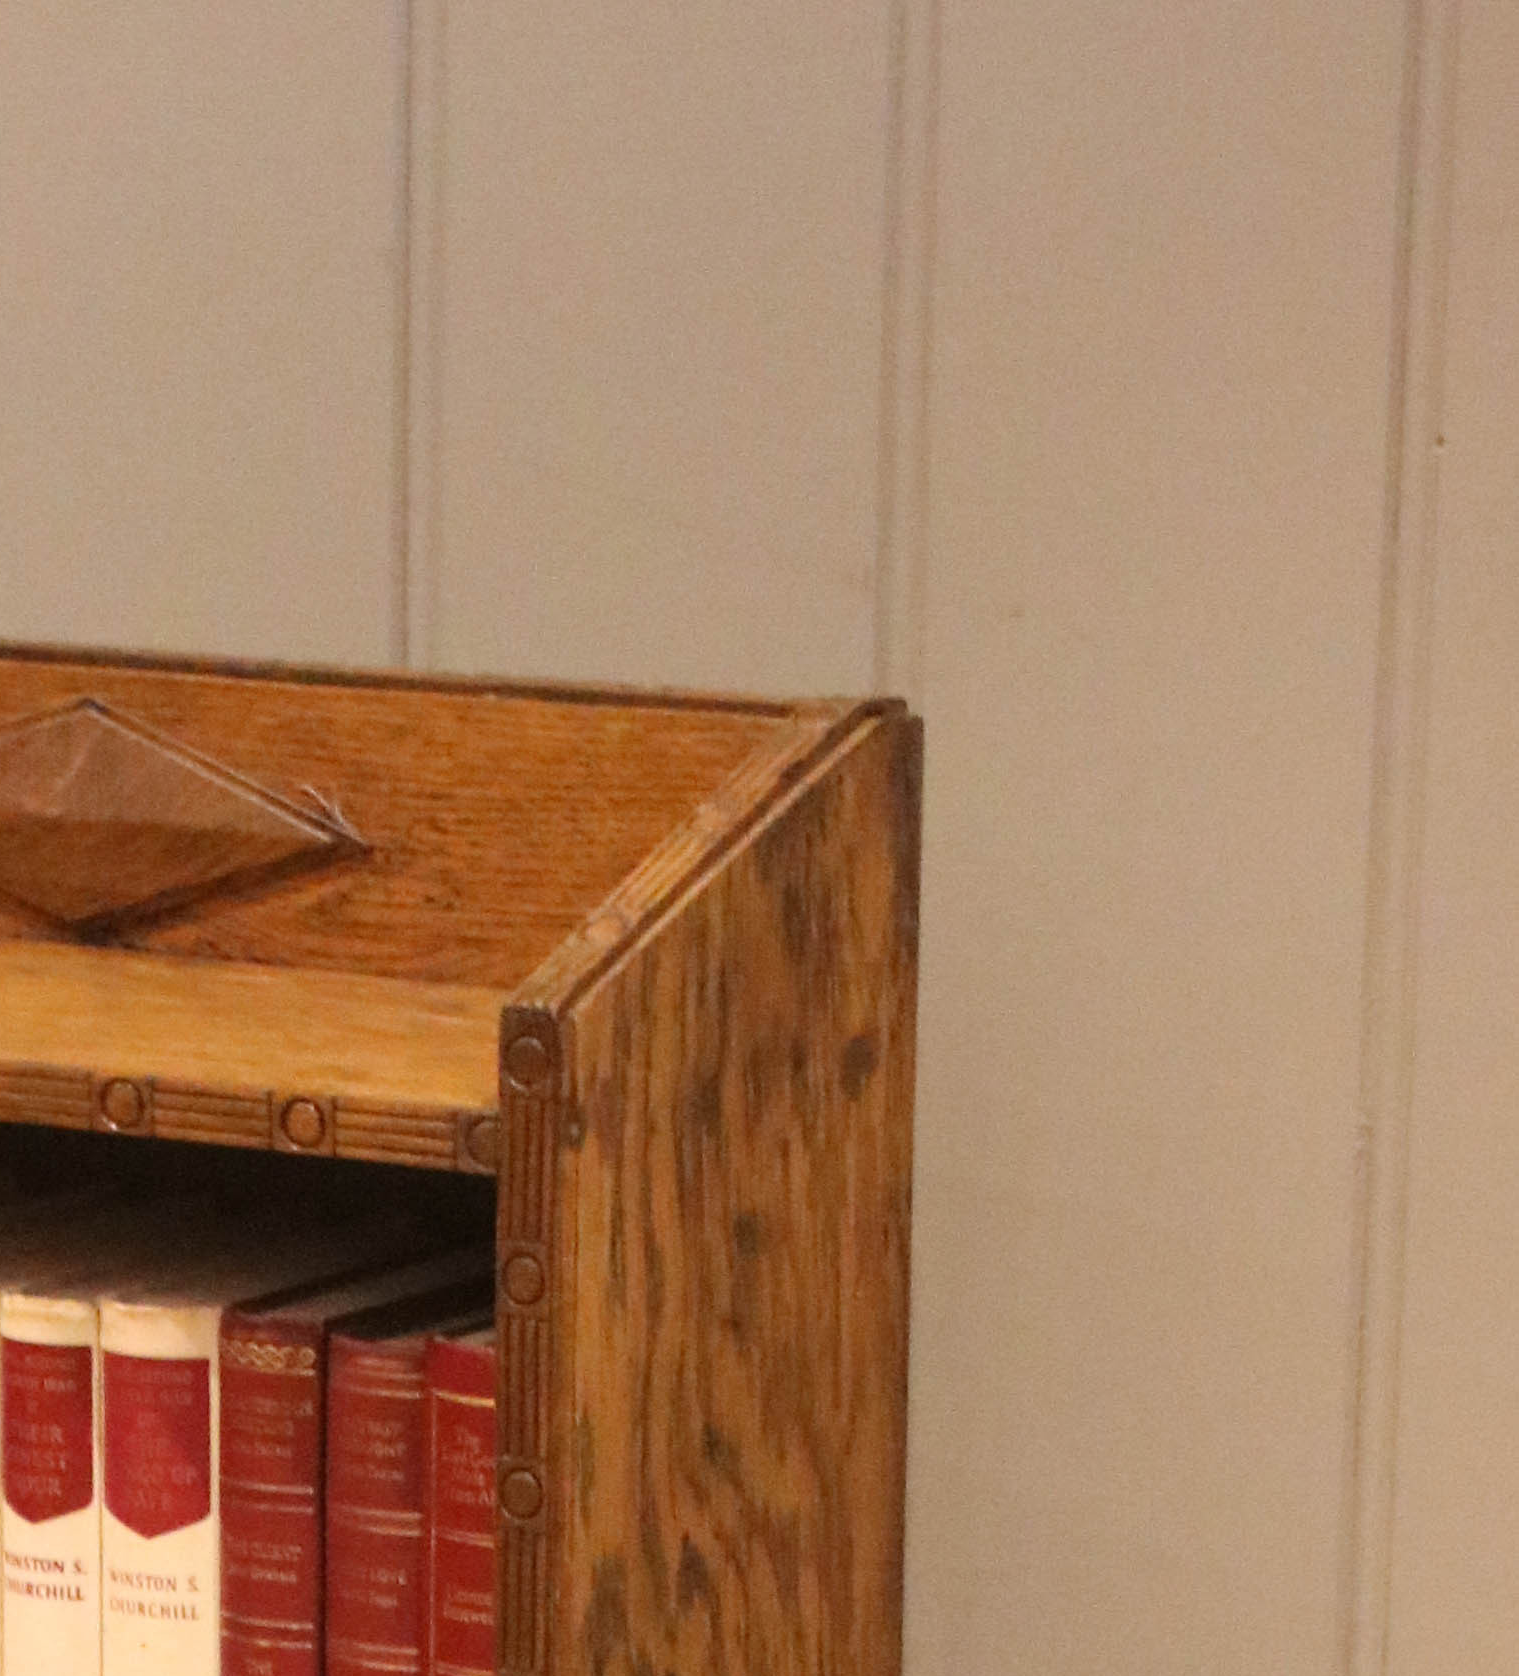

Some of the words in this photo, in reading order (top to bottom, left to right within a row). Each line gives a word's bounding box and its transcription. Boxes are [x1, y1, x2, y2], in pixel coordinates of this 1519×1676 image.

[5, 1551, 65, 1573] WINSTON
[4, 1579, 84, 1601] CHURCHILL
[109, 1568, 177, 1591] WINSTON
[109, 1599, 199, 1620] CHURCHILL
